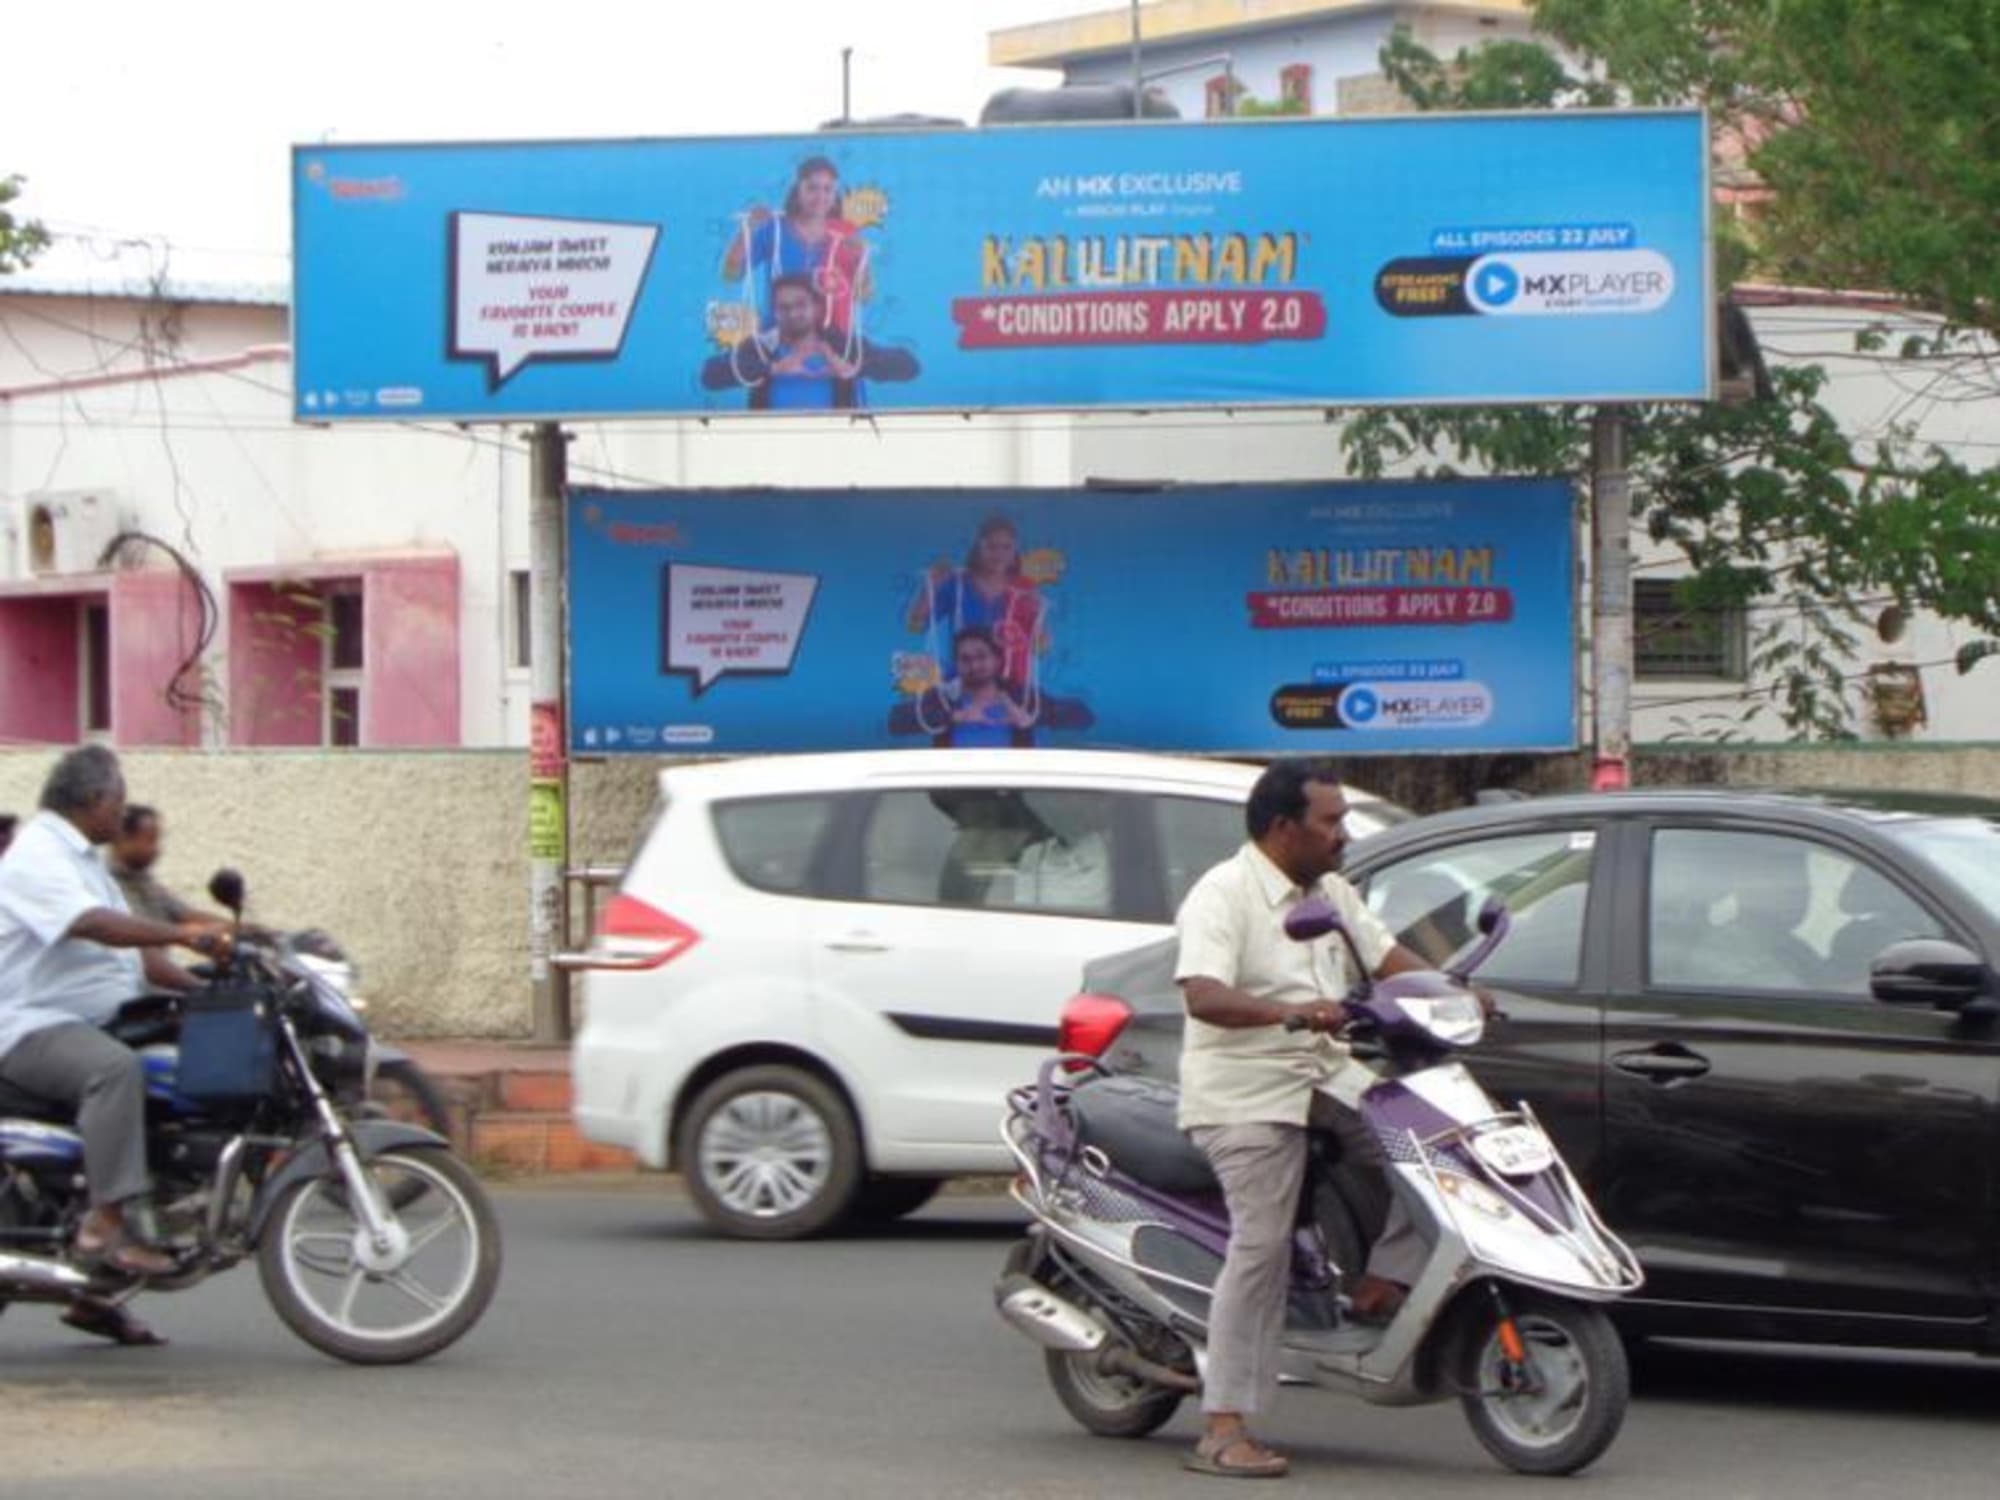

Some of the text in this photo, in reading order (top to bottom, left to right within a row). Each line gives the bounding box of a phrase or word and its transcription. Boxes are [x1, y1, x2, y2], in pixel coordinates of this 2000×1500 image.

[1077, 174, 1113, 195] MX
[1118, 171, 1242, 193] EXCLUSIVE
[1435, 232, 1467, 248] ALL
[1471, 230, 1555, 247] EPISODES
[1588, 228, 1629, 245] JULY
[1164, 299, 1246, 331] APPLY
[1261, 298, 1300, 329] 2.0
[1398, 593, 1457, 616] APPLY
[1467, 591, 1496, 613] 2.0
